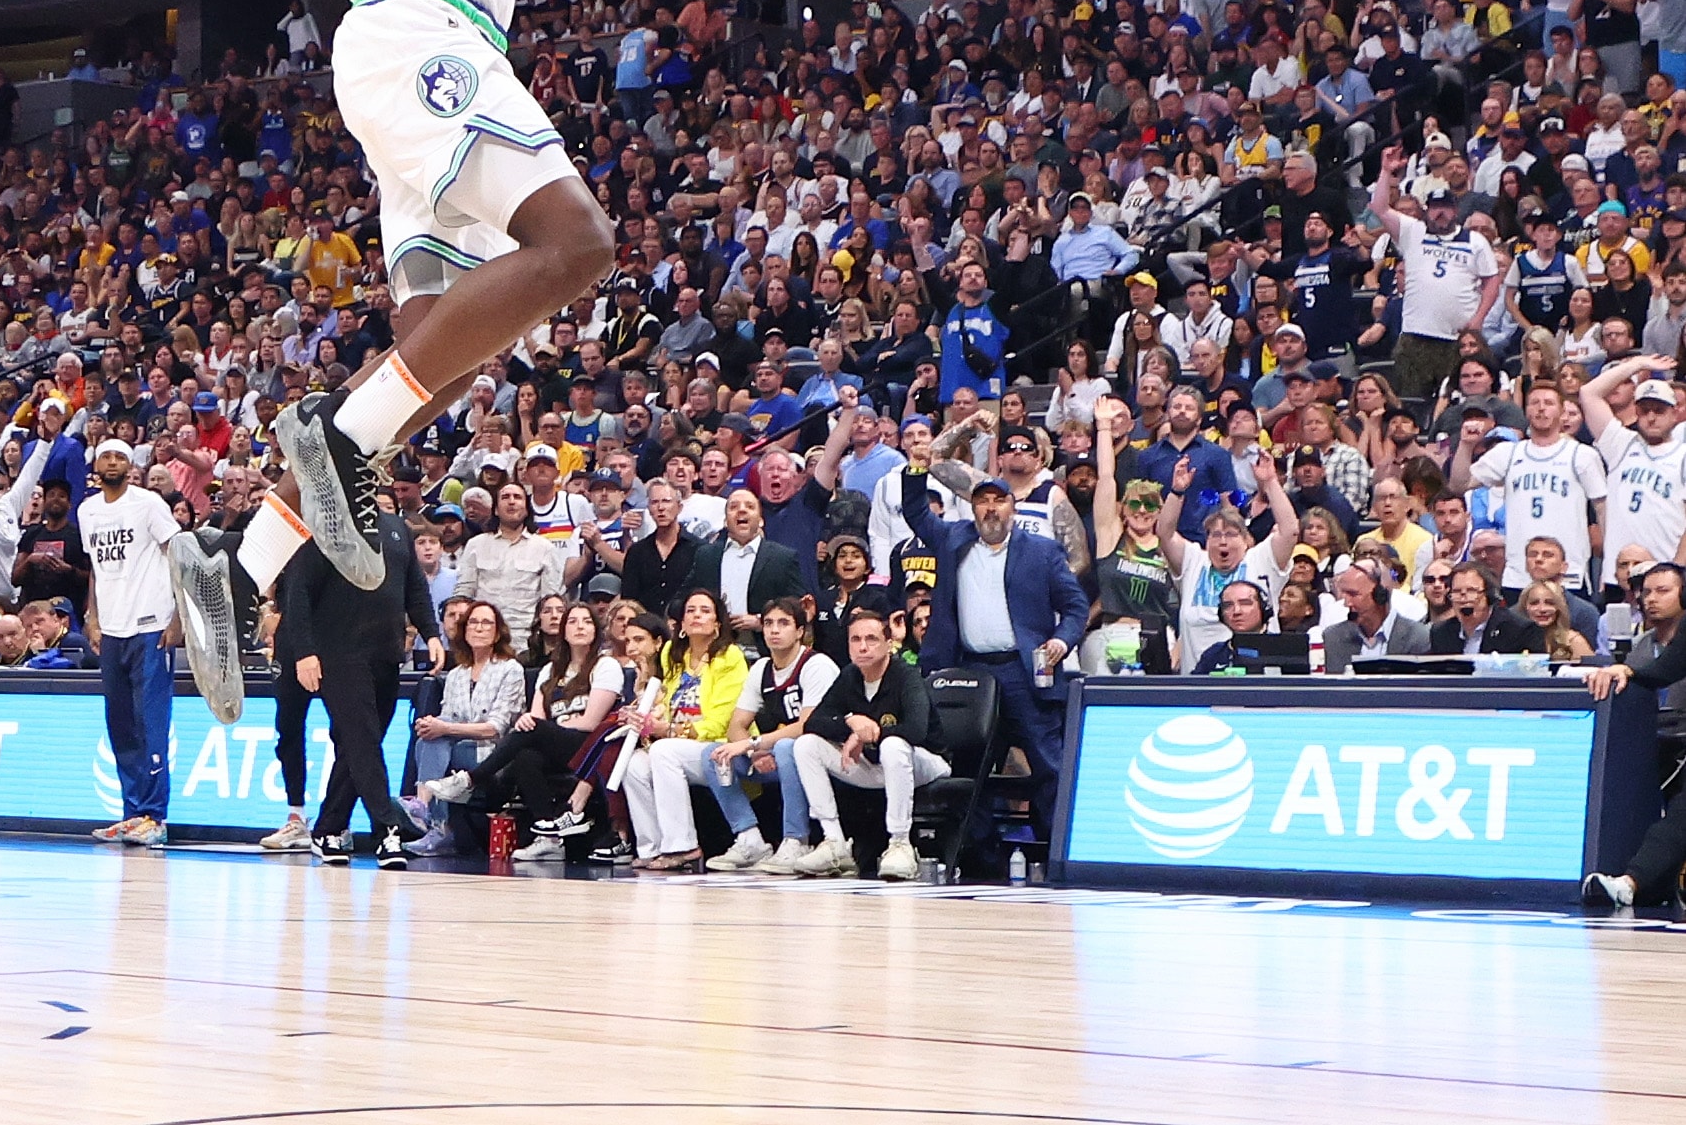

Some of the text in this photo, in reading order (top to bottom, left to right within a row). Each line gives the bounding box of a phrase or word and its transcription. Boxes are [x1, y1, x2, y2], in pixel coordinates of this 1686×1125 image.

[1422, 246, 1469, 264] WOLVES
[1433, 259, 1448, 278] 5
[1304, 287, 1316, 308] 5
[1541, 294, 1554, 313] 5
[1512, 472, 1570, 498] WOLVES
[1621, 467, 1672, 500] WOLVES
[1531, 496, 1544, 519] 5
[1628, 490, 1643, 514] 5
[89, 529, 134, 549] WOLVES
[96, 545, 125, 563] BACK
[783, 691, 802, 720] 15
[1269, 744, 1535, 841] AT&T
